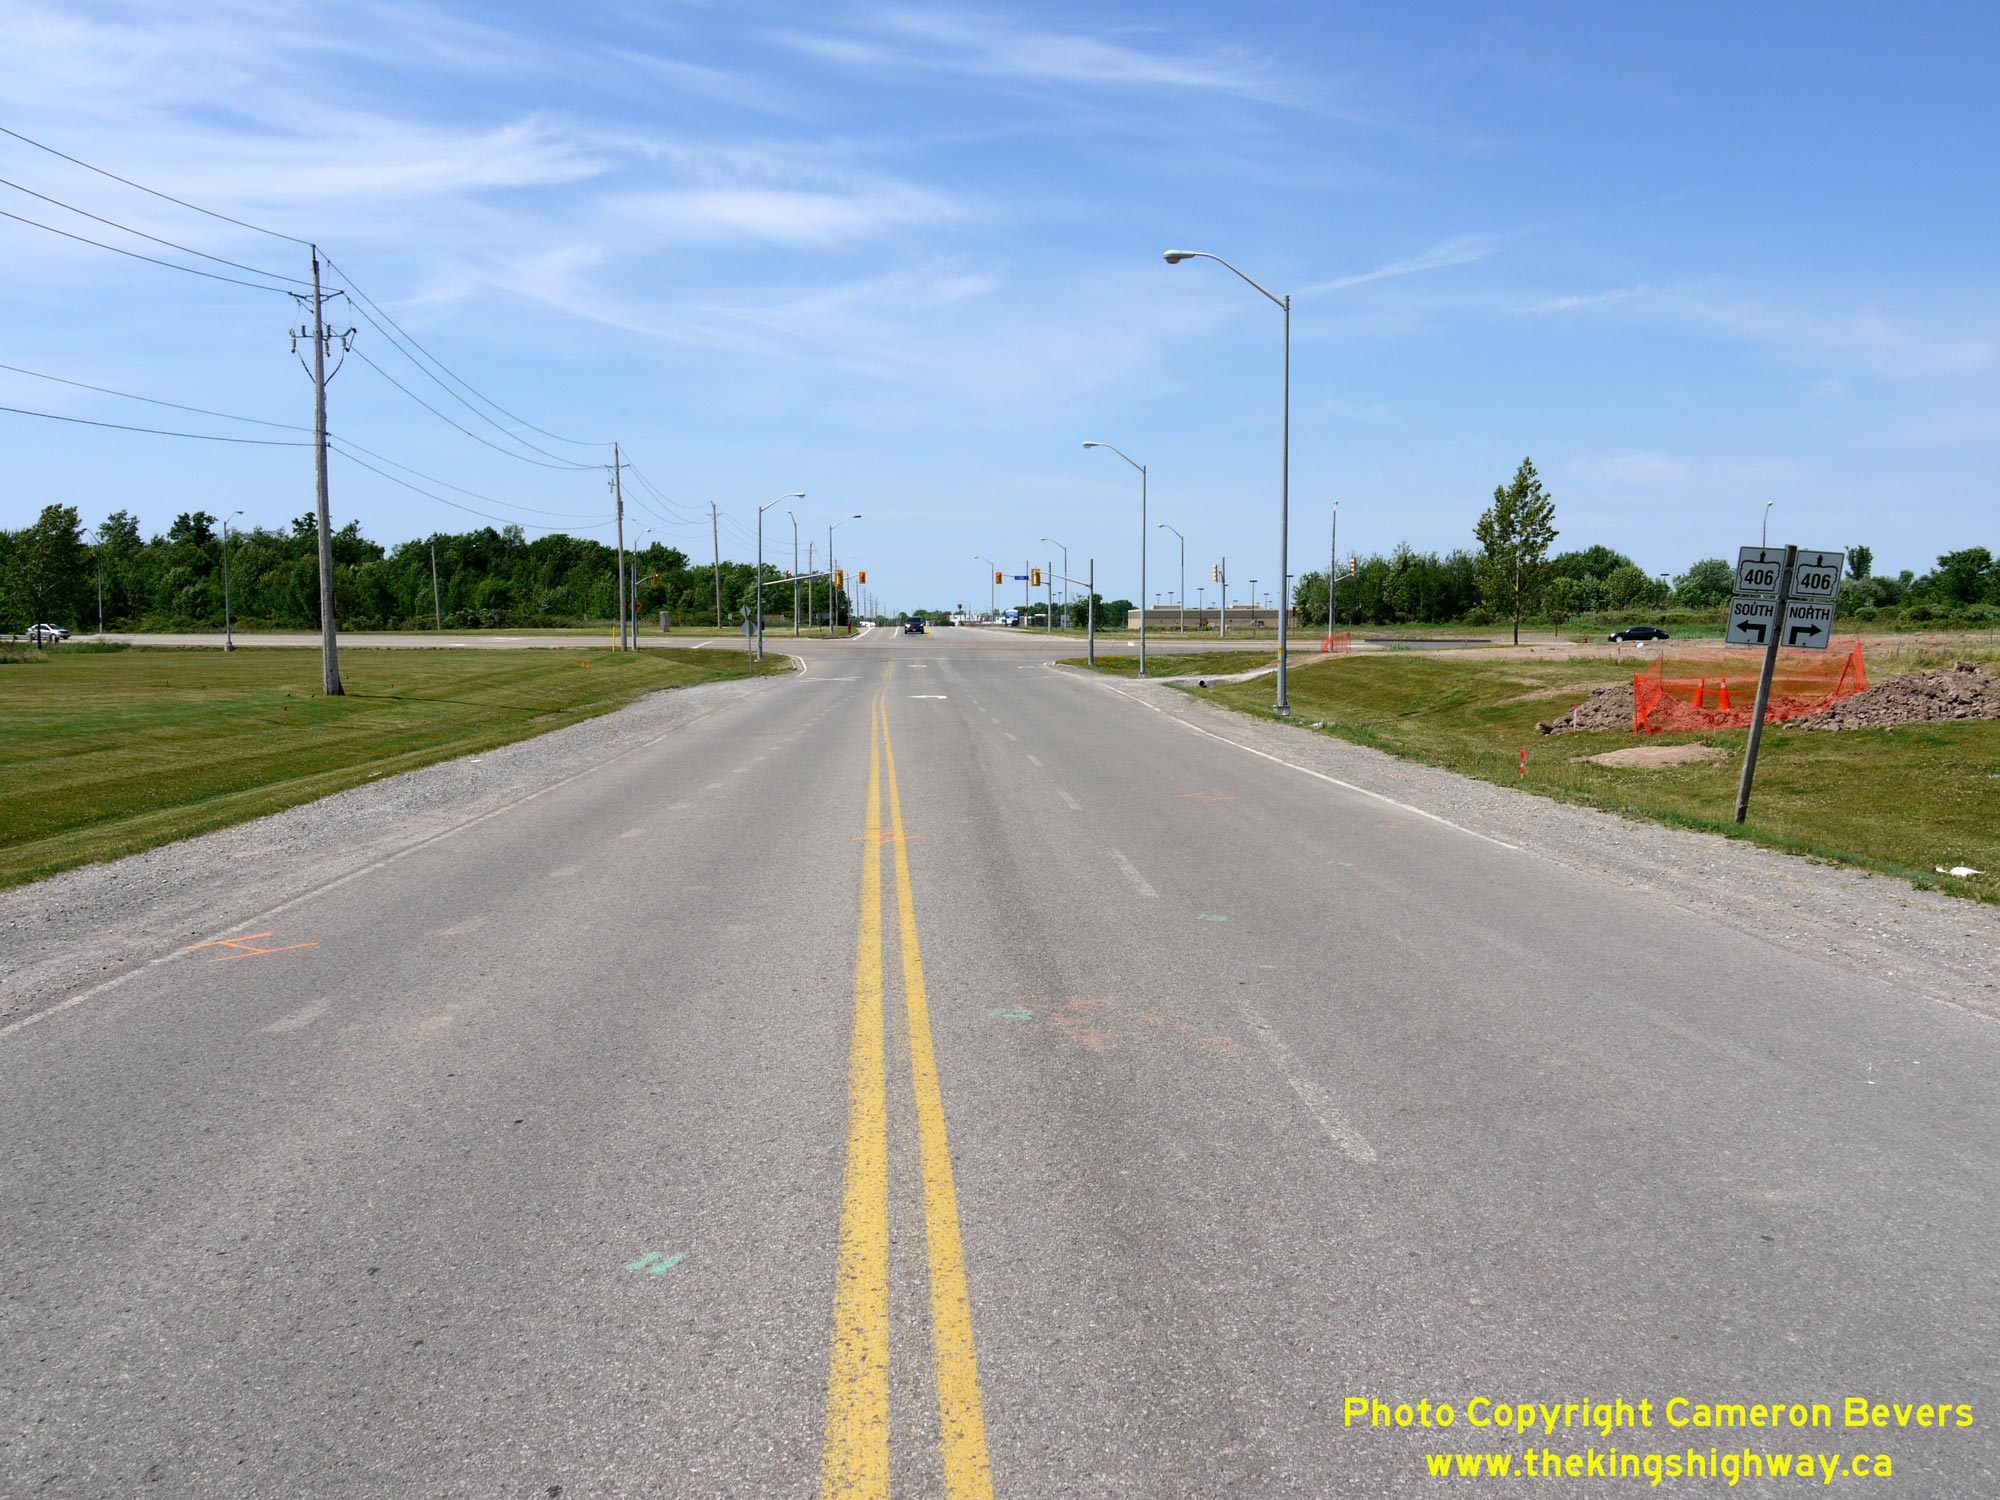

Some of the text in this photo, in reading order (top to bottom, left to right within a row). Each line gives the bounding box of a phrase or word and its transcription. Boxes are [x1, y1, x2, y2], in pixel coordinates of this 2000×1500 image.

[1744, 569, 1774, 586] 406
[1801, 573, 1832, 590] 406
[1734, 603, 1774, 617] SOUTH
[1789, 606, 1830, 620] NORTH
